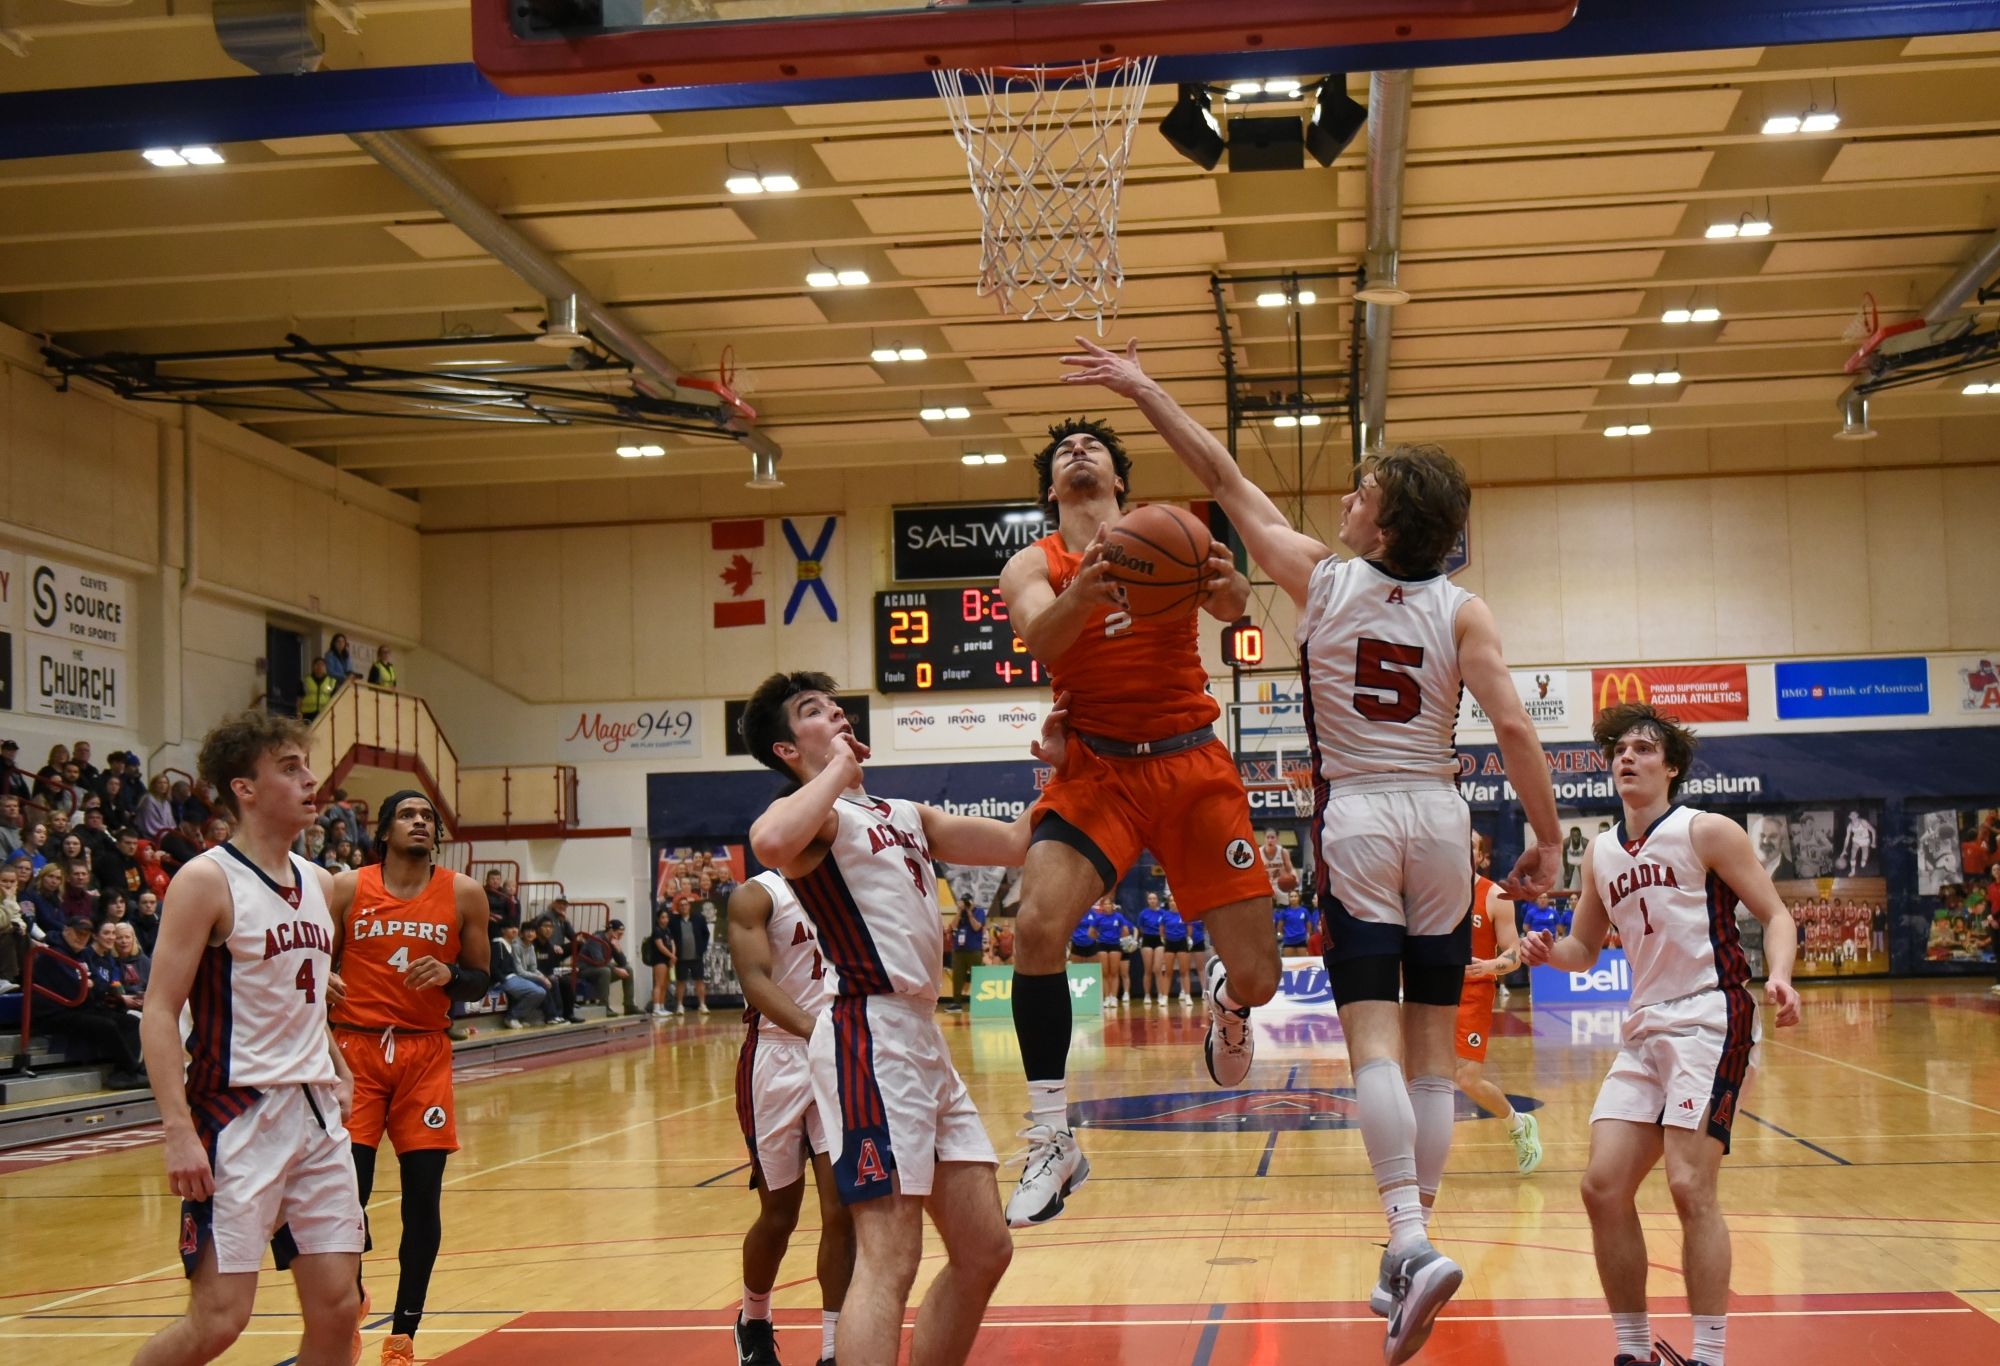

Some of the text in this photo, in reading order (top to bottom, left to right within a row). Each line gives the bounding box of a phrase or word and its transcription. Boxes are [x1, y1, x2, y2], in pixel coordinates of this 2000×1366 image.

[64, 592, 122, 624] SOURCE
[884, 593, 927, 608] ACADIA
[1385, 585, 1405, 606] A
[69, 623, 117, 642] FOR SPORTS
[889, 610, 930, 645] 23
[963, 640, 993, 653] period
[1234, 629, 1262, 662] 10
[40, 655, 116, 708] CHURCH
[884, 672, 906, 683] fouls
[916, 662, 933, 688] 0
[942, 668, 971, 681] player
[1352, 636, 1425, 724] 5
[1650, 682, 1730, 693] PROUD SUPPORTER OF
[1651, 692, 1742, 705] ACADIA ATHLETICS
[1781, 683, 1924, 698] BMO Bank of Montreal
[54, 699, 88, 719] BREWING
[897, 716, 935, 726] IRVING
[948, 714, 986, 724] IRVING
[999, 713, 1037, 723] IRVING
[565, 710, 693, 753] Magic 94.9
[1481, 749, 1611, 776] AMEN
[924, 798, 1025, 820] brating
[1504, 778, 1613, 802] Morial
[1608, 865, 1680, 908] ACADIA
[1638, 897, 1655, 936] 1
[263, 922, 332, 960] ACADIA
[353, 918, 449, 946] CAPERS
[387, 946, 409, 973] 4
[295, 958, 316, 1004] 4
[1569, 959, 1628, 992] Bell
[854, 1137, 888, 1187] A
